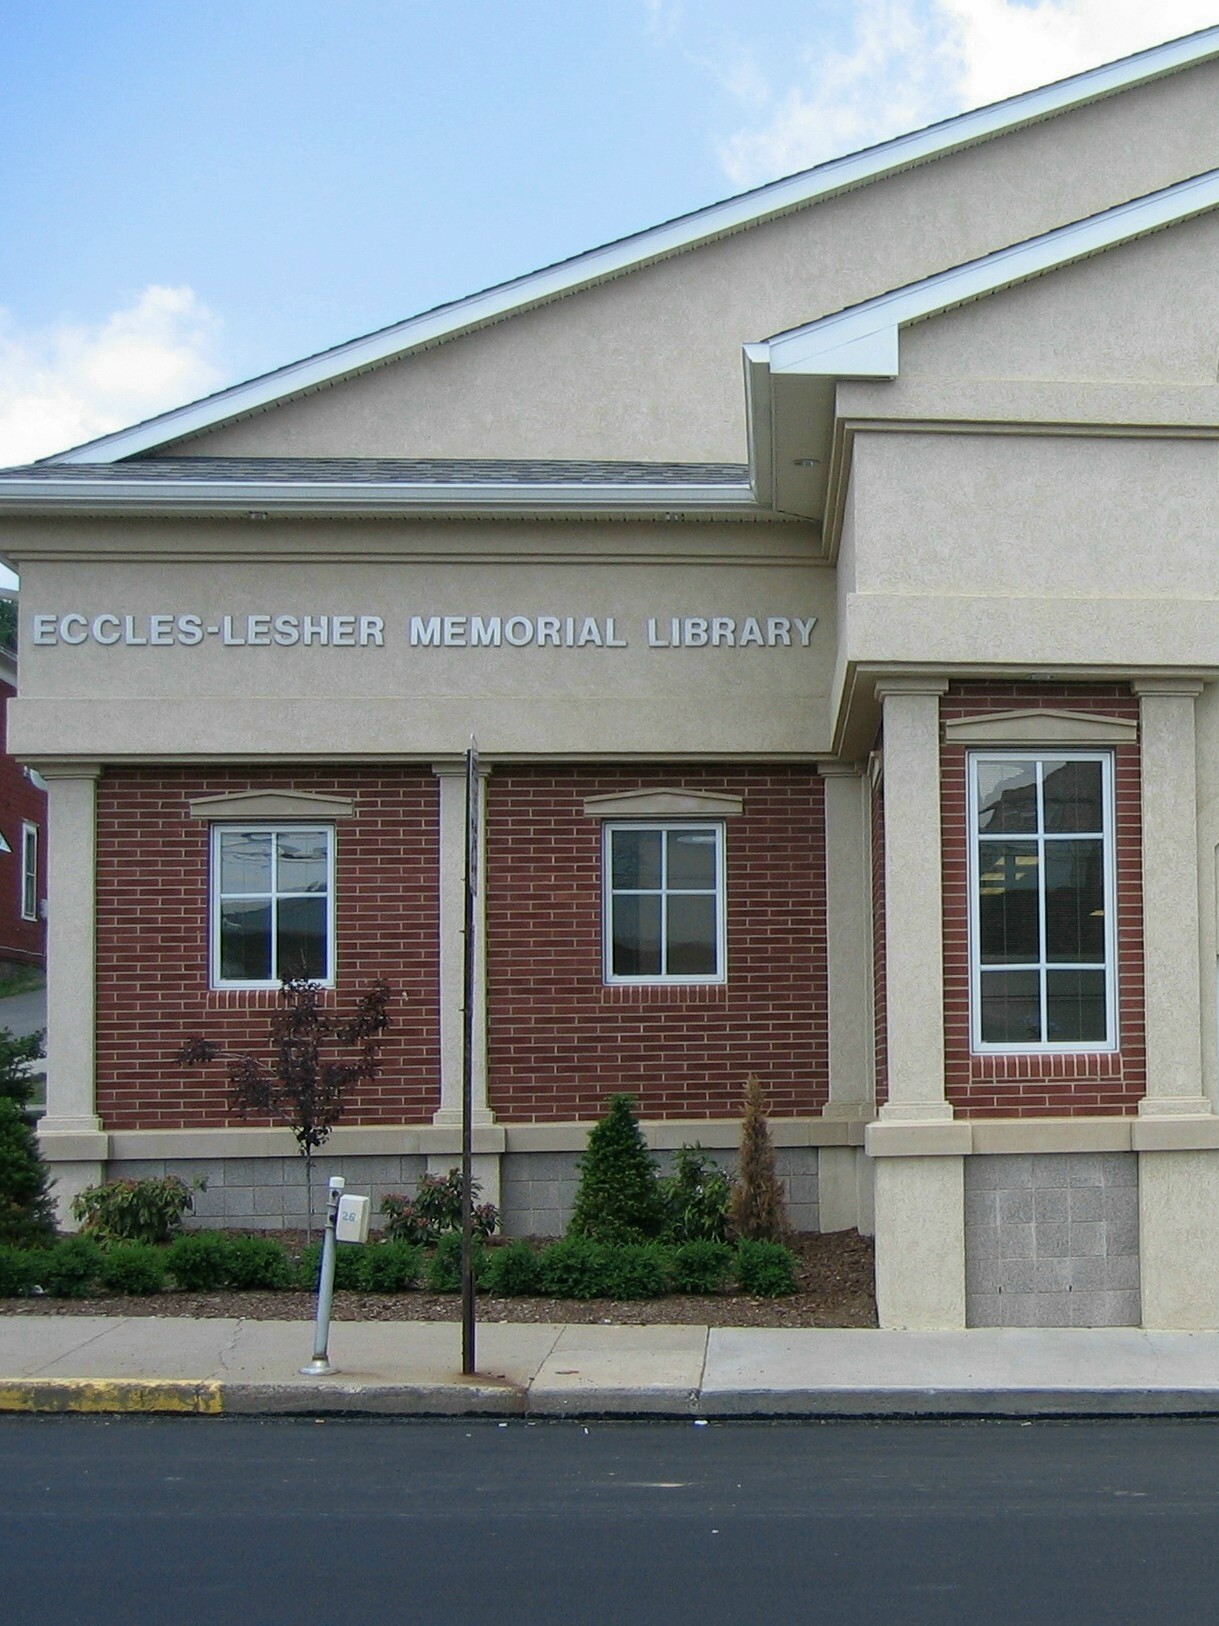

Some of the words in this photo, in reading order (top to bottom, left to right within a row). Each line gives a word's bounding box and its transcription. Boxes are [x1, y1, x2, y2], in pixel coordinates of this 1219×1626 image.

[32, 613, 386, 647] ECCLES-LESHER
[409, 614, 628, 648] MEMORIAL
[646, 616, 818, 648] LIBRARY
